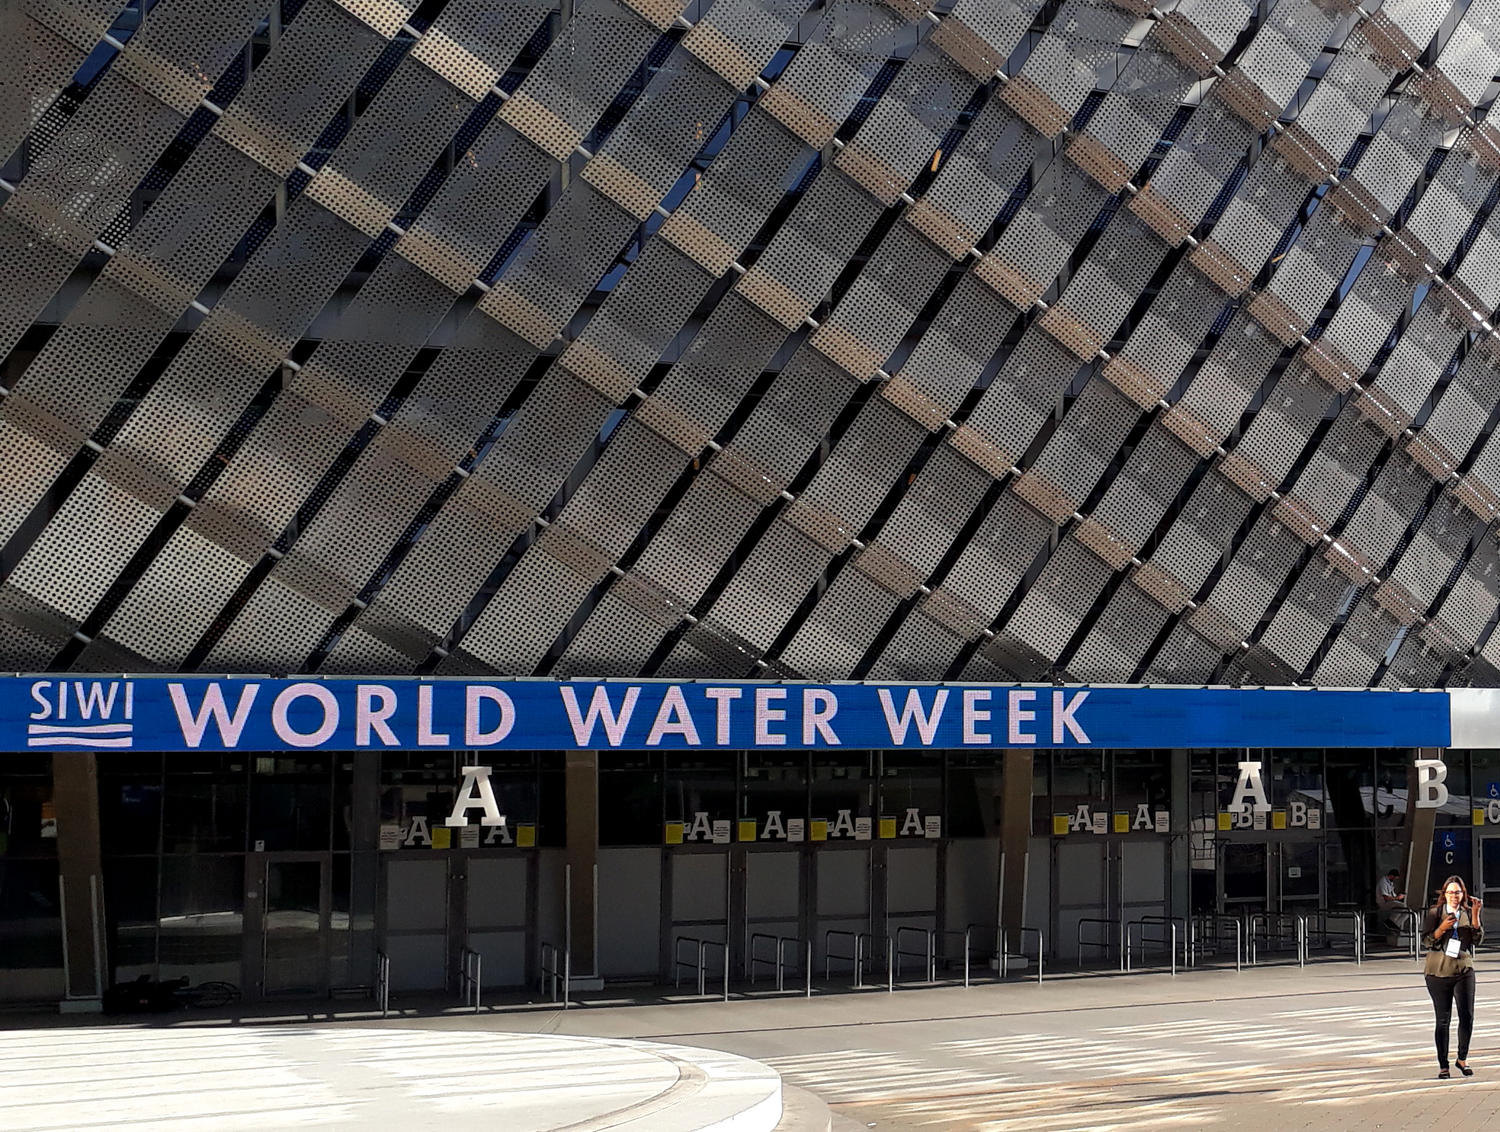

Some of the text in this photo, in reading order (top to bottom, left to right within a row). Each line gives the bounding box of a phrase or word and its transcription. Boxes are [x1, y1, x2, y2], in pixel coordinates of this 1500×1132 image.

[30, 681, 134, 720] SIWI
[168, 683, 1092, 748] WORLD WATER WEEK
[445, 766, 505, 826] A
[1227, 761, 1272, 812] A
[1414, 759, 1449, 809] B
[687, 811, 714, 840] A
[760, 810, 787, 839] A
[831, 809, 856, 837] A
[900, 808, 925, 836] A
[1071, 805, 1094, 832] A
[1132, 803, 1154, 830] A
[1290, 801, 1307, 827] B
[404, 816, 433, 846] A
[1445, 851, 1454, 865] C
